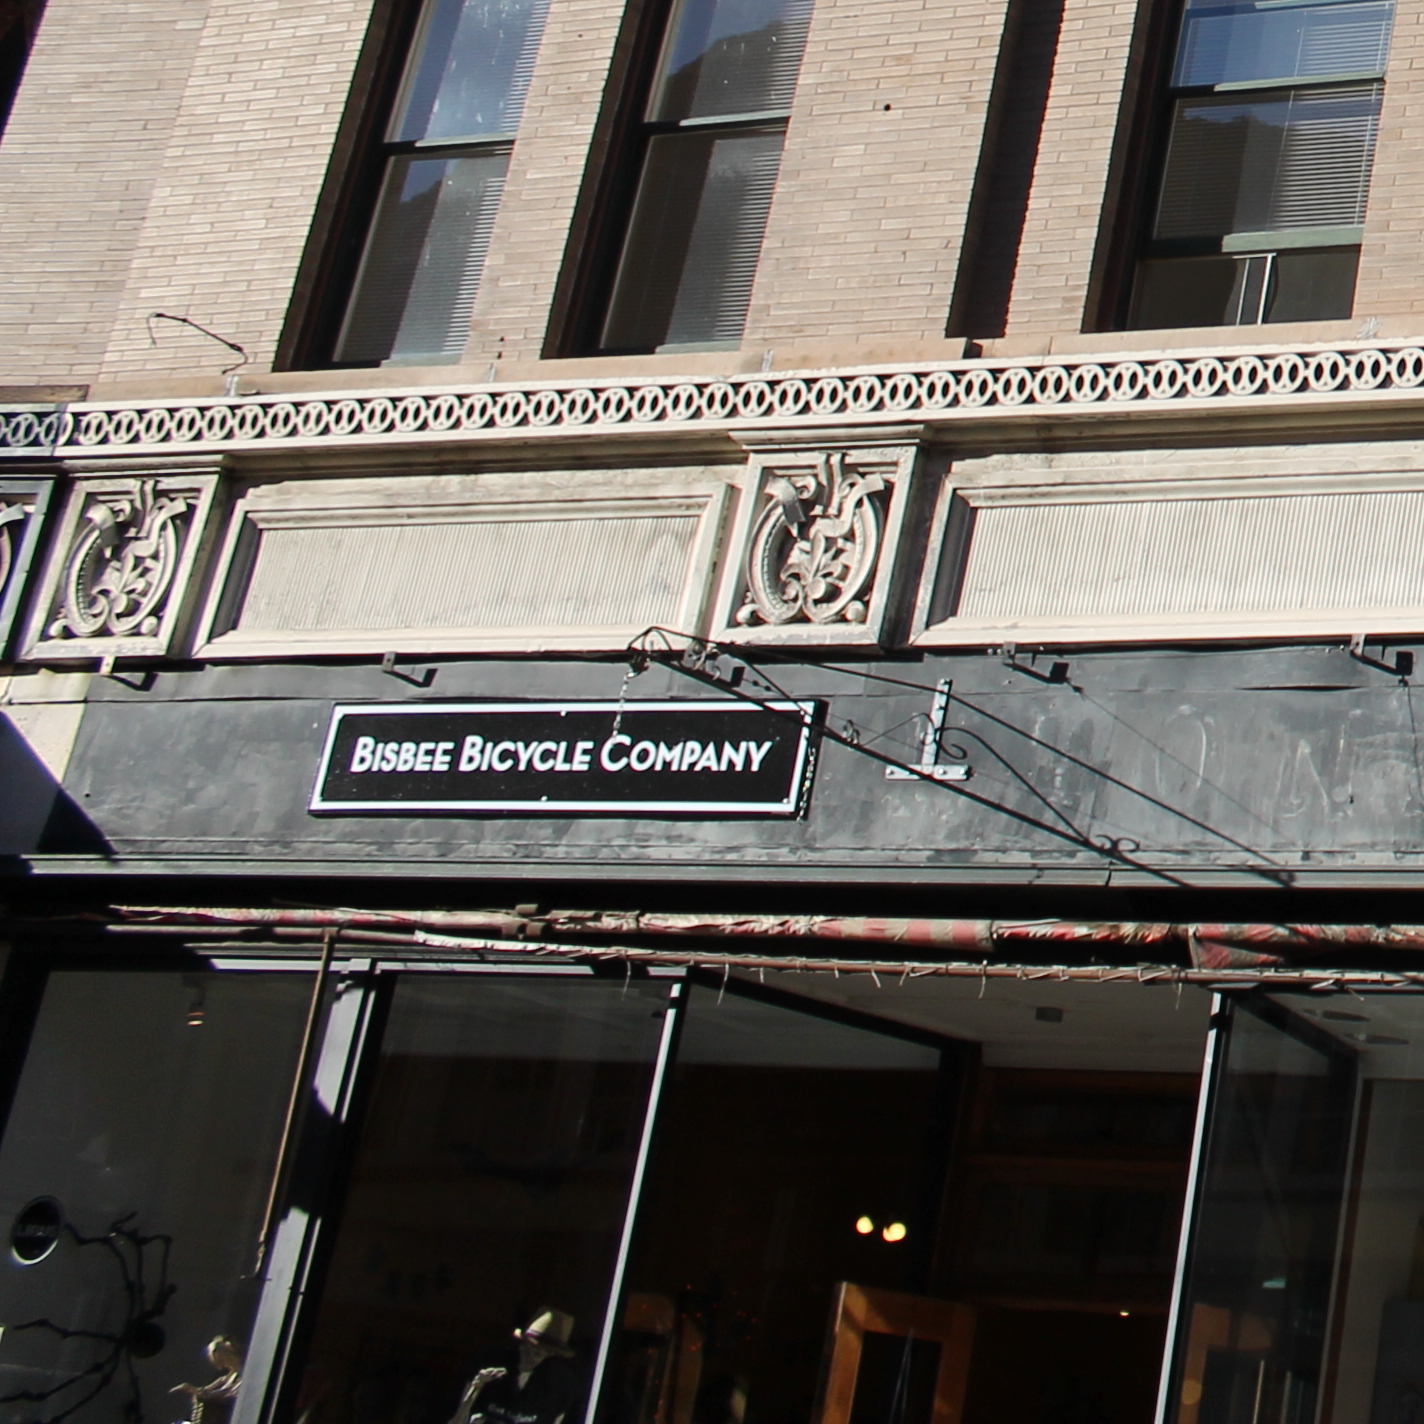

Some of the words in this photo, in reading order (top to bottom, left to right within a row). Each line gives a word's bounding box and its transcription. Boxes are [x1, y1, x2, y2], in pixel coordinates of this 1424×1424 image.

[350, 735, 455, 772] BISBEE
[458, 734, 594, 772] BICYCLE
[600, 733, 773, 772] COMPANY
